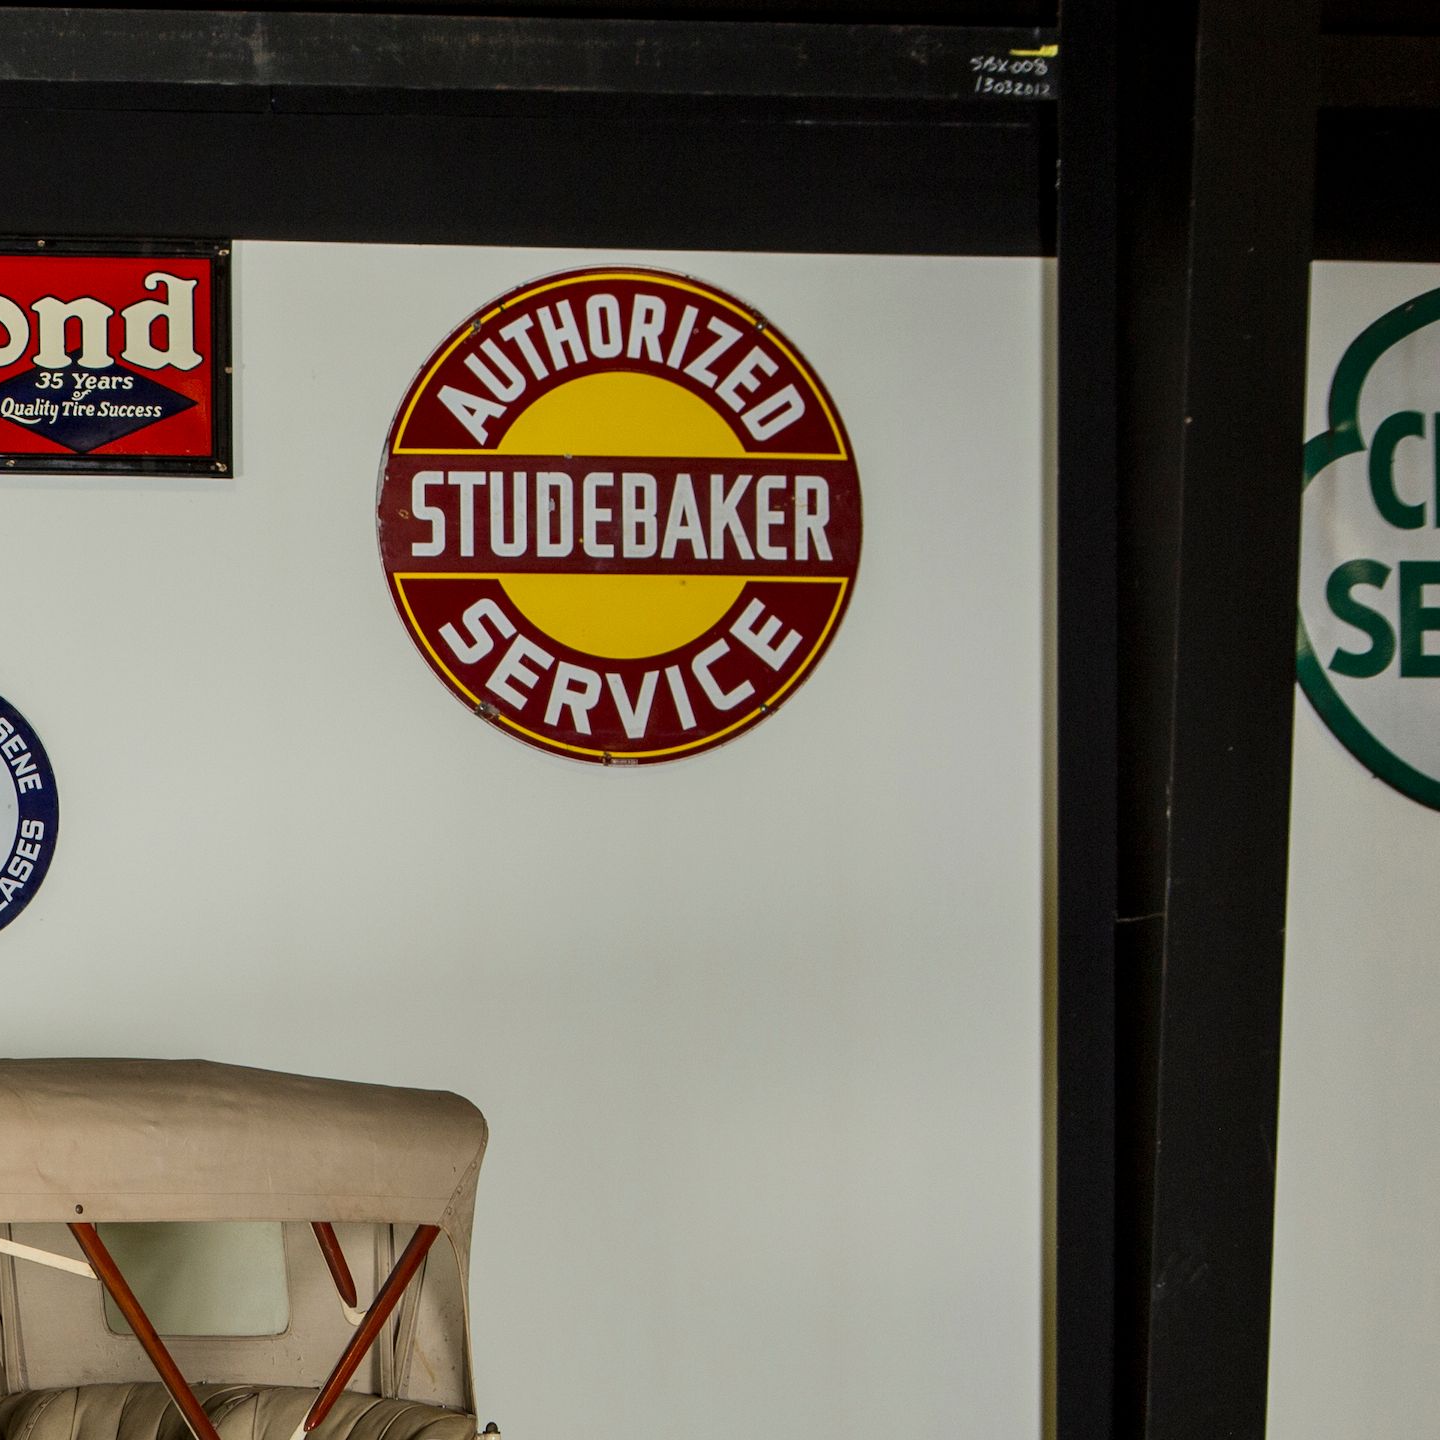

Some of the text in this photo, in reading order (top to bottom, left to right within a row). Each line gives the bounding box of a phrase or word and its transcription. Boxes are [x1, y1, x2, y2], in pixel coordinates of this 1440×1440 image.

[35, 372, 134, 390] 35 Years
[71, 389, 92, 401] of
[436, 293, 806, 446] AUTHORIZED
[0, 397, 162, 425] Quality Tire Success
[411, 470, 834, 561] STUDEBAKER
[438, 597, 804, 740] SERVICE
